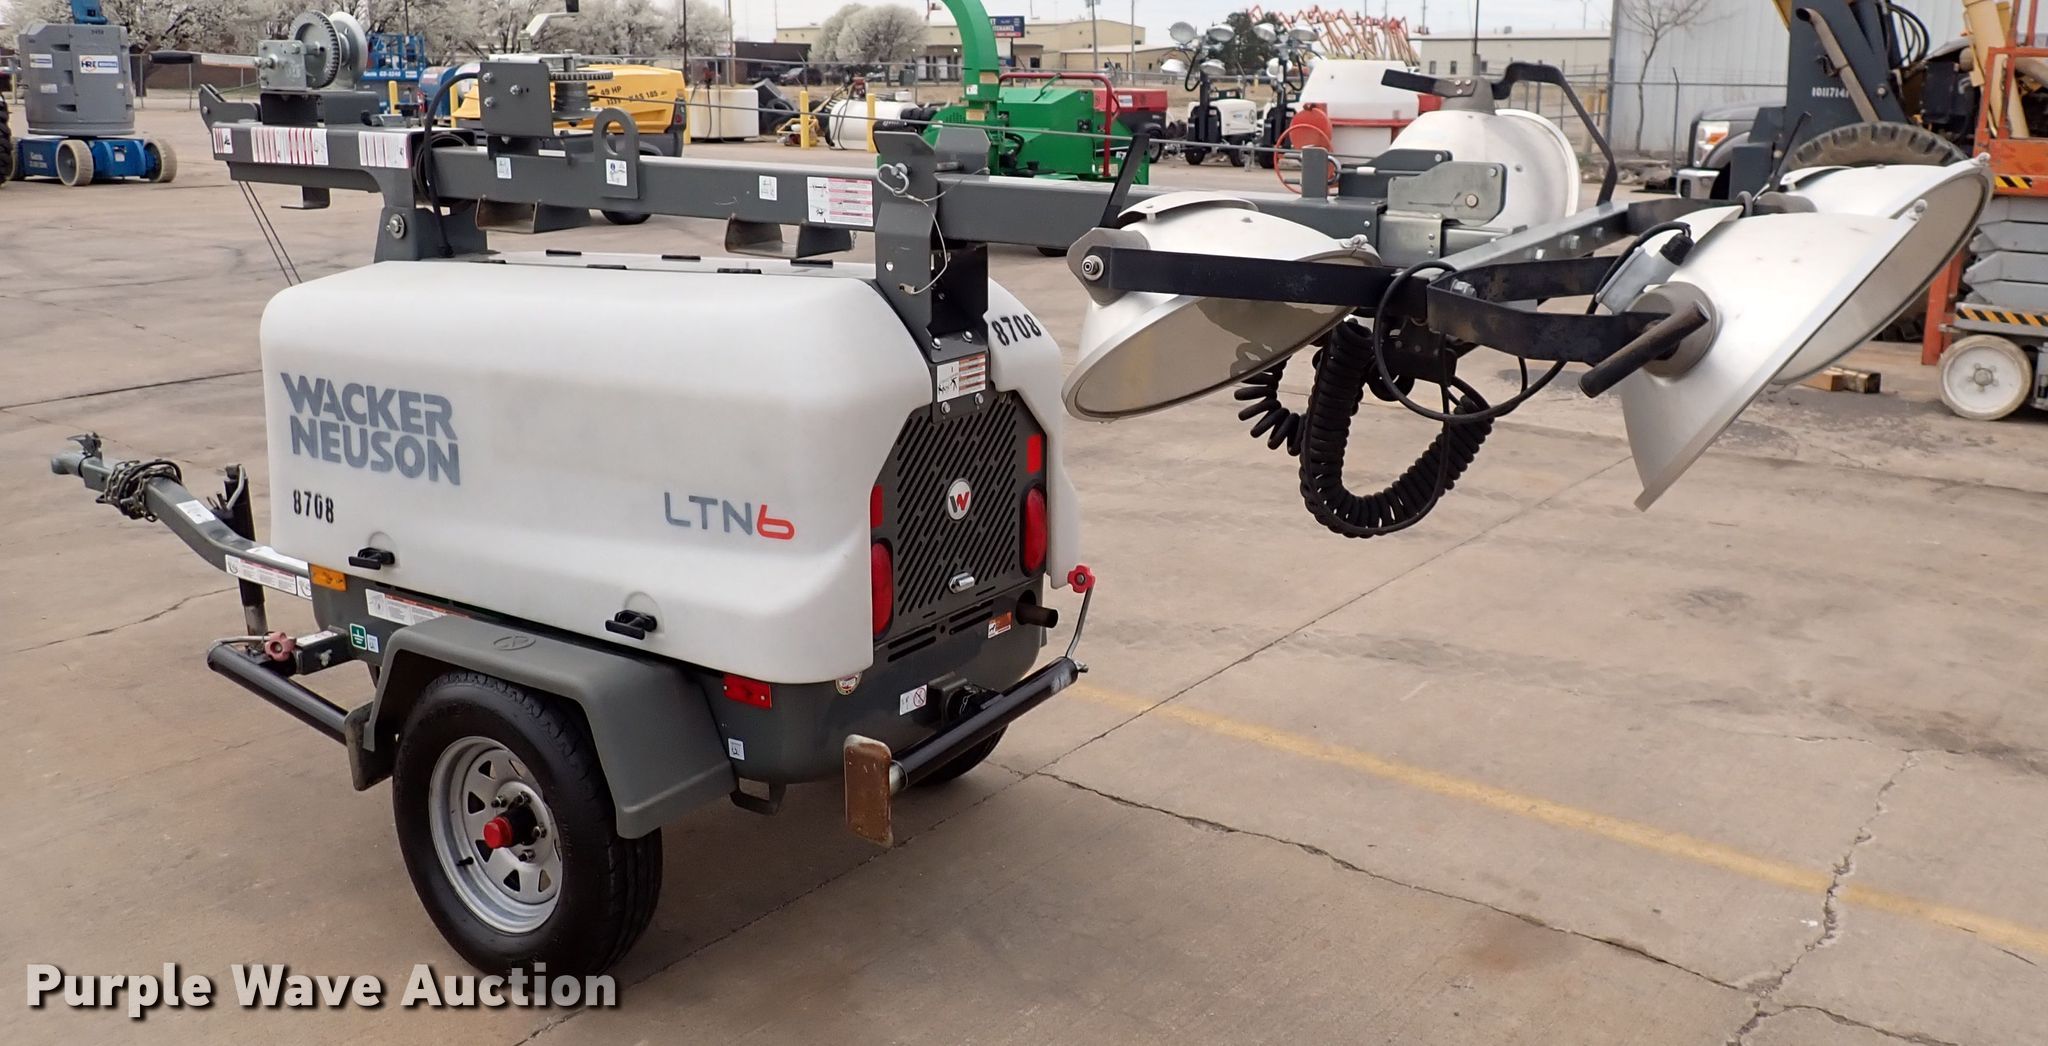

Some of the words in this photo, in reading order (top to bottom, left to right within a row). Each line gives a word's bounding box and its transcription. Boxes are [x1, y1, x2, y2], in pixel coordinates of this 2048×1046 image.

[600, 88, 610, 96] 49
[611, 85, 622, 94] HP
[991, 314, 1042, 346] 8708
[280, 372, 458, 441] WACKER
[290, 415, 461, 486] NEUSON
[293, 489, 335, 524] 8708
[664, 491, 795, 541] LTN6
